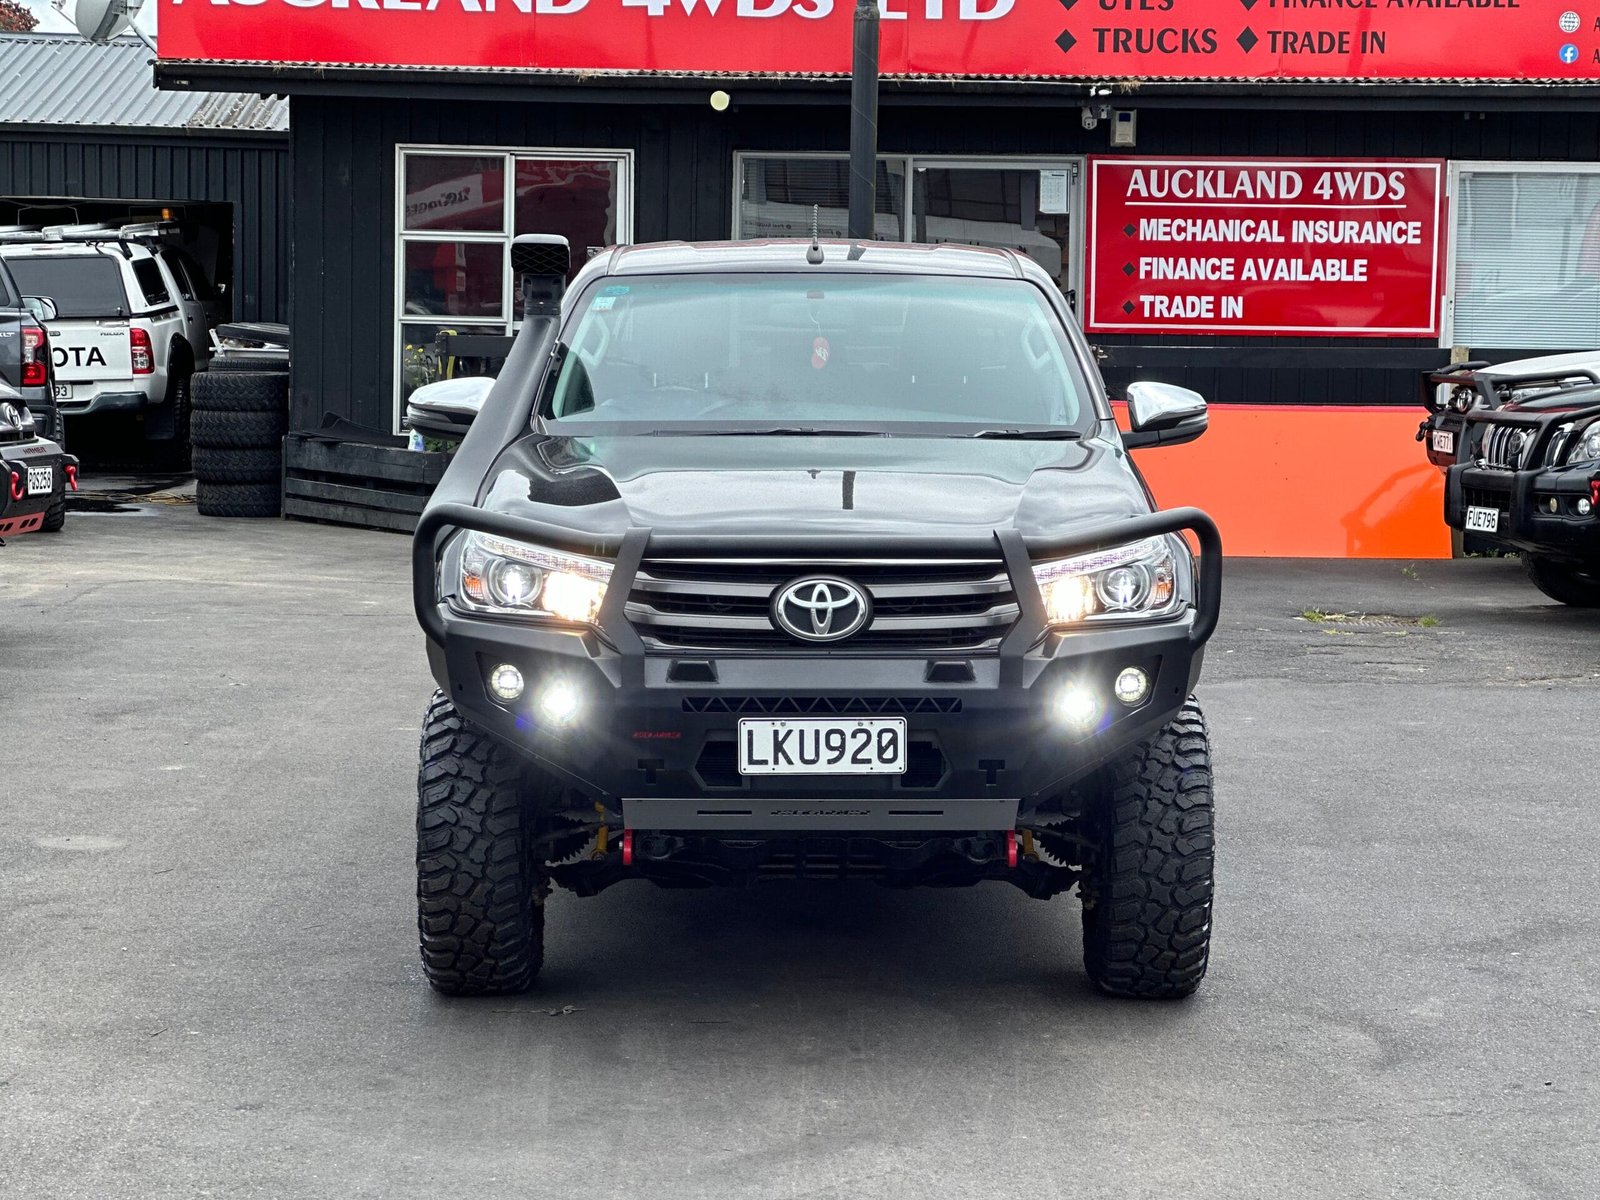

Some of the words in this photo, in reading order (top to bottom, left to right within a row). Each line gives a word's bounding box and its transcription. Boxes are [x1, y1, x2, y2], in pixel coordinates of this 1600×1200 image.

[1093, 28, 1217, 54] TRUCKS
[1267, 31, 1349, 54] TRADE
[1361, 31, 1386, 54] IN
[1126, 168, 1303, 199] AUCKLAND
[1312, 171, 1406, 200] 4WDS
[1139, 218, 1285, 243] MECHANICAL
[1291, 220, 1422, 245] INSURANCE
[1139, 256, 1235, 281] FINANCE
[1240, 258, 1368, 282] AVAILABLE
[1139, 294, 1215, 319] TRADE
[1220, 295, 1244, 319] IN
[1467, 509, 1497, 530] FUE796
[747, 727, 899, 766] LKU920
